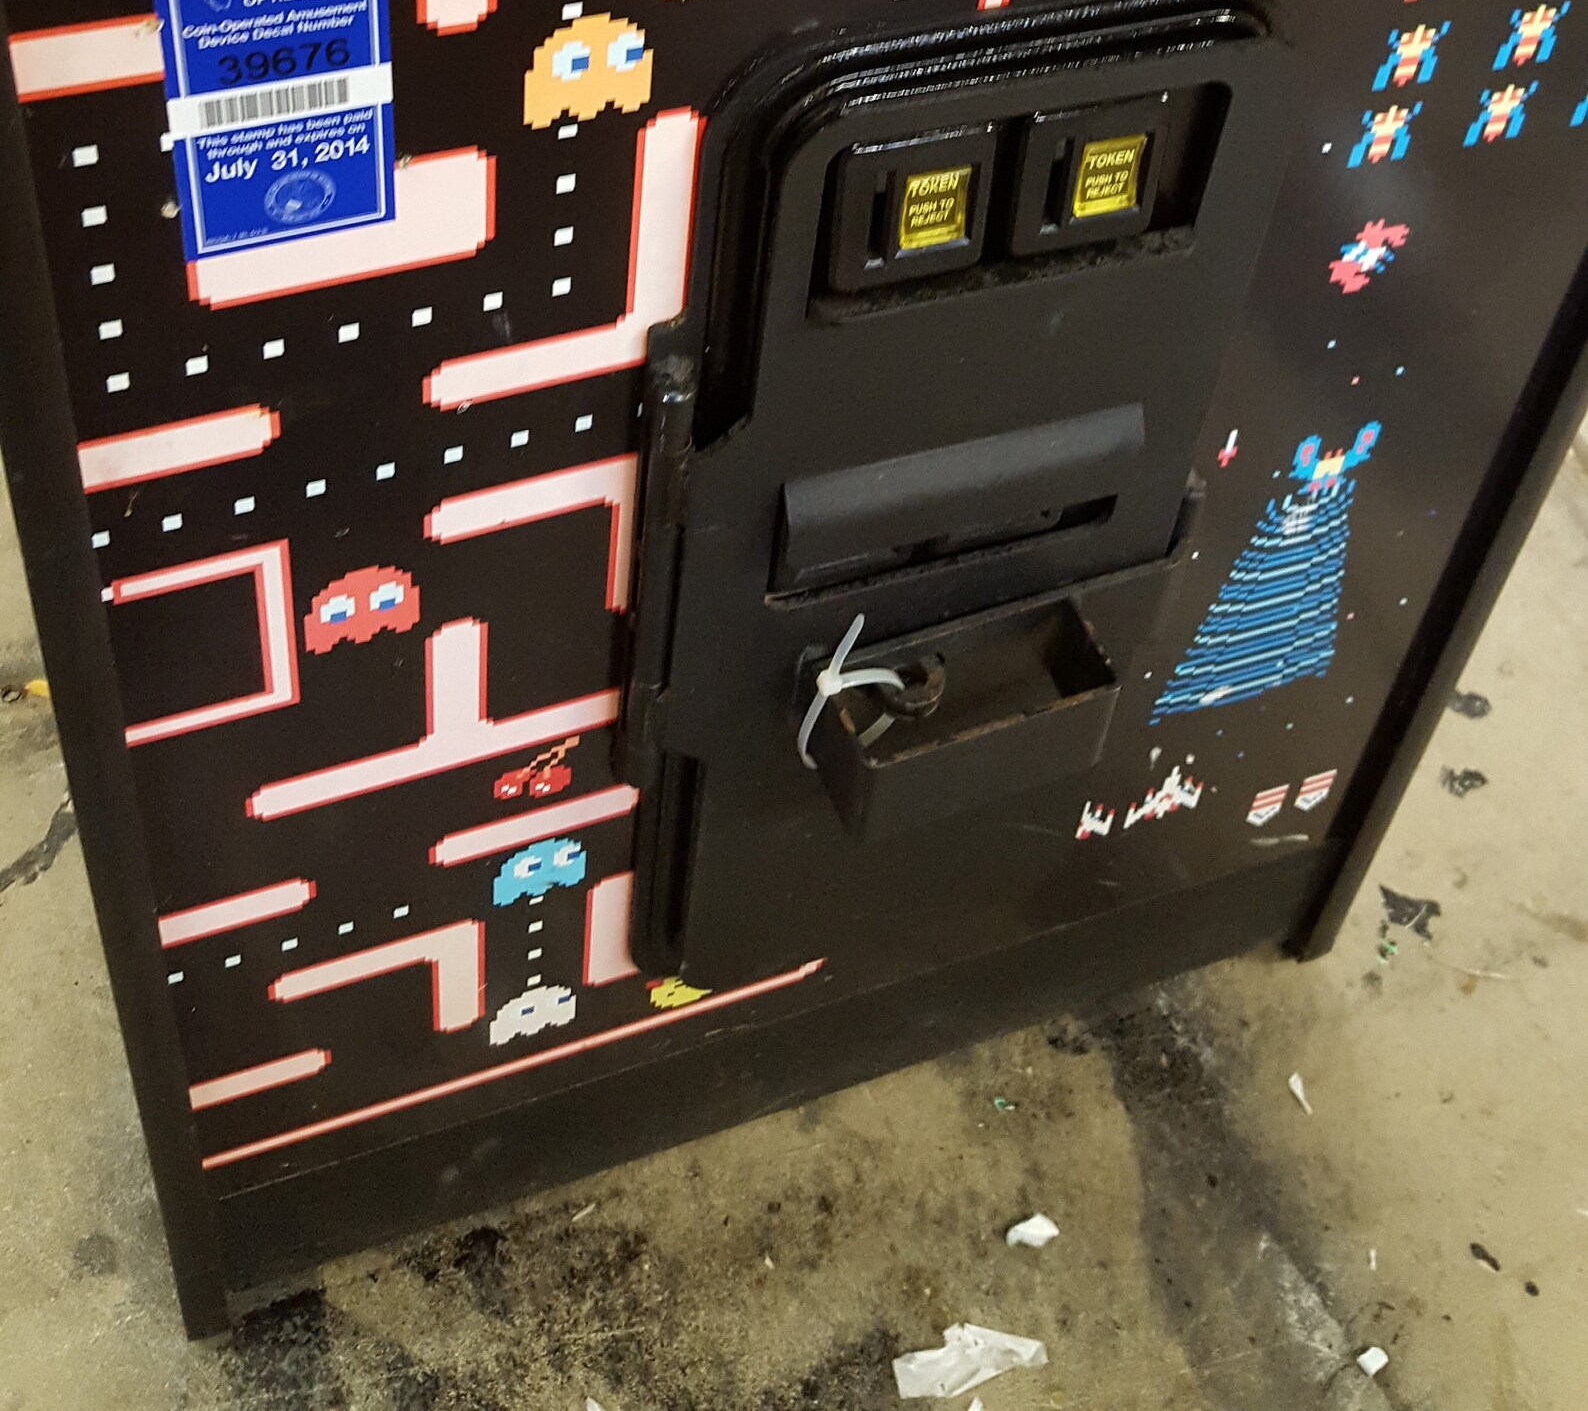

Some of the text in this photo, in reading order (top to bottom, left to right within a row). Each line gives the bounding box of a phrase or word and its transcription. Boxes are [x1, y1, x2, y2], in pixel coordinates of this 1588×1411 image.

[198, 31, 249, 50] Device
[297, 14, 356, 33] Number
[218, 38, 350, 85] 39676
[306, 114, 340, 131] been
[205, 134, 371, 183] July 31, 2014
[1089, 148, 1135, 170] TOKEN
[908, 171, 960, 198] TOKEN
[1085, 170, 1129, 188] PUSH TO
[1086, 181, 1125, 200] REJECT
[909, 197, 955, 217] PUSH TO
[911, 209, 951, 228] REJECT
